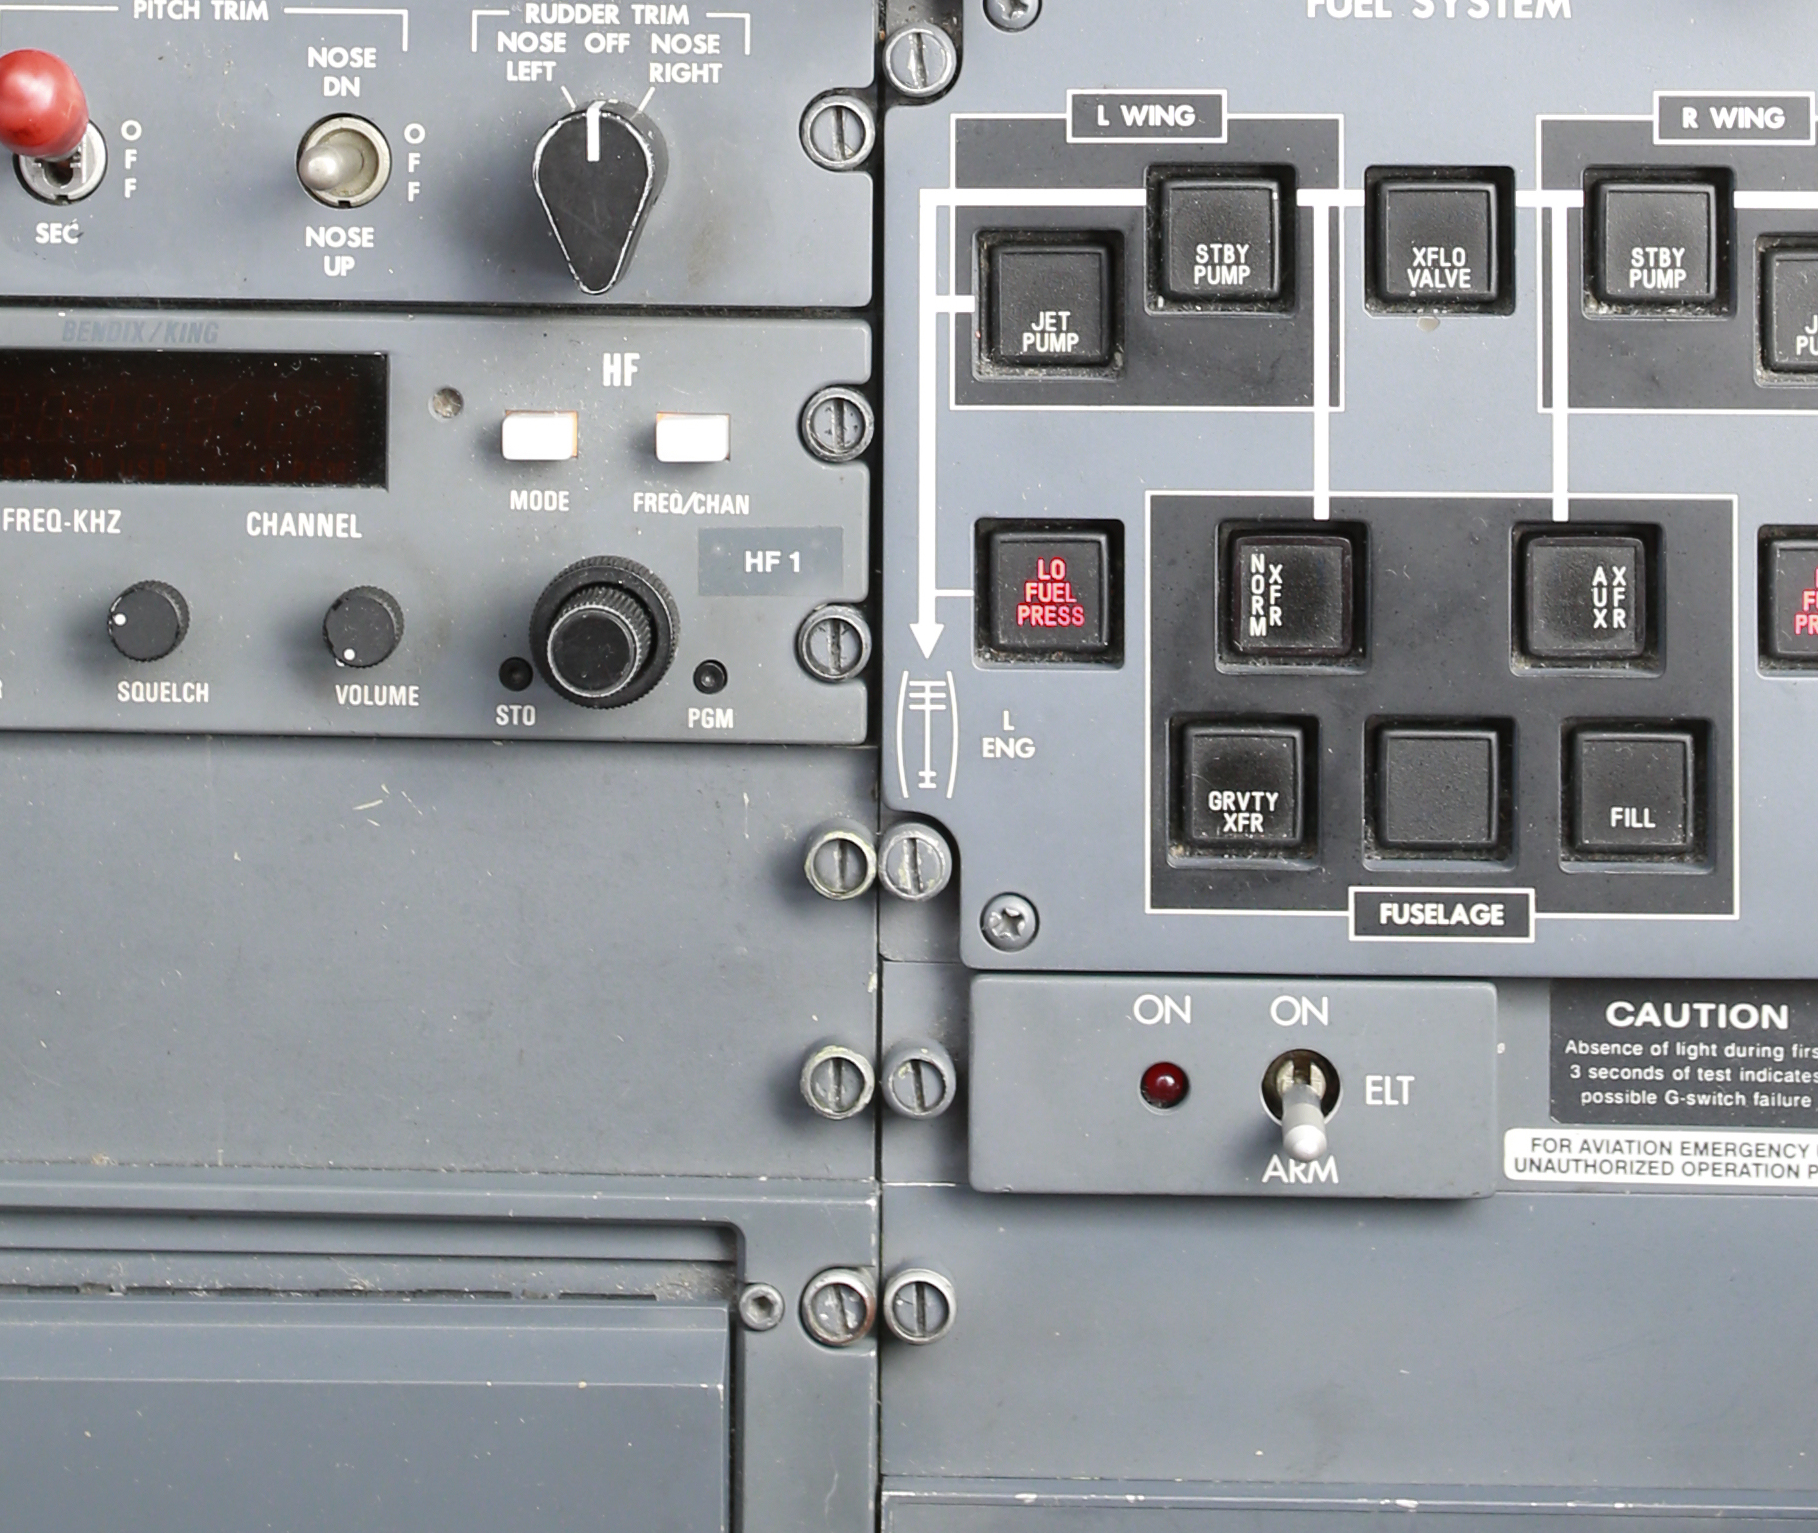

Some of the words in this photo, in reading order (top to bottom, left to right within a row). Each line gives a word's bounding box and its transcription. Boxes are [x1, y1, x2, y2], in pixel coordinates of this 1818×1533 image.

[134, 0, 200, 19] PITCH
[211, 0, 268, 20] TRIM
[526, 3, 620, 24] RUDDER
[631, 5, 689, 25] TRIM
[498, 31, 566, 52] NOSE
[585, 33, 630, 53] OFF
[652, 33, 720, 54] NOSE
[308, 47, 376, 68] NOSE
[507, 61, 556, 81] LEFT
[650, 63, 722, 83] RIGHT
[324, 76, 360, 97] DN
[1098, 105, 1109, 126] L
[1121, 105, 1195, 126] WING
[1683, 107, 1698, 128] R
[1710, 107, 1785, 129] WING
[36, 223, 78, 244] SEC
[1196, 244, 1249, 264] STBY
[1413, 247, 1465, 267] XFLO
[1195, 265, 1250, 284] PUMP
[1407, 269, 1471, 288] VALVE
[1032, 311, 1070, 331] JET
[1023, 333, 1079, 352] PUMP
[603, 353, 640, 386] HF
[510, 490, 569, 511] MODE
[634, 492, 749, 514] FREQ/CHAN
[3, 508, 121, 533] FREQ-KHZ
[247, 512, 362, 538] CHANNEL
[746, 551, 781, 572] HF
[790, 552, 799, 572] 1
[1038, 557, 1066, 581] LO
[1025, 581, 1077, 603] FUEL
[1016, 603, 1085, 628] PRESS
[118, 681, 208, 702] SQUELCH
[336, 685, 419, 706] VOLUME
[496, 705, 535, 726] STO
[689, 708, 733, 728] PGM
[1209, 791, 1278, 811] GRVTY
[1224, 813, 1263, 832] XFR
[1611, 807, 1655, 828] FILL
[1380, 903, 1504, 925] FUSELAGE
[1134, 995, 1190, 1024] ON
[1271, 996, 1328, 1026] ON
[1606, 1002, 1788, 1029] CAUTION
[1565, 1040, 1643, 1055] Absence
[1651, 1041, 1668, 1056] of
[1676, 1042, 1717, 1060] light
[1724, 1043, 1784, 1061] during
[1571, 1065, 1580, 1078] 3
[1589, 1066, 1664, 1080] seconds
[1673, 1066, 1690, 1080] of
[1697, 1068, 1731, 1081] test
[1366, 1076, 1414, 1105] ELT
[1581, 1090, 1657, 1106] possible
[1665, 1090, 1746, 1106] G-switch
[1754, 1092, 1811, 1107] failure
[1532, 1138, 1571, 1153] FOR
[1579, 1139, 1671, 1155] AVIATION
[1681, 1141, 1809, 1158] EMERGENCY
[1515, 1158, 1674, 1175] UNAUTHORIZED
[1682, 1161, 1799, 1178] OPERATION
